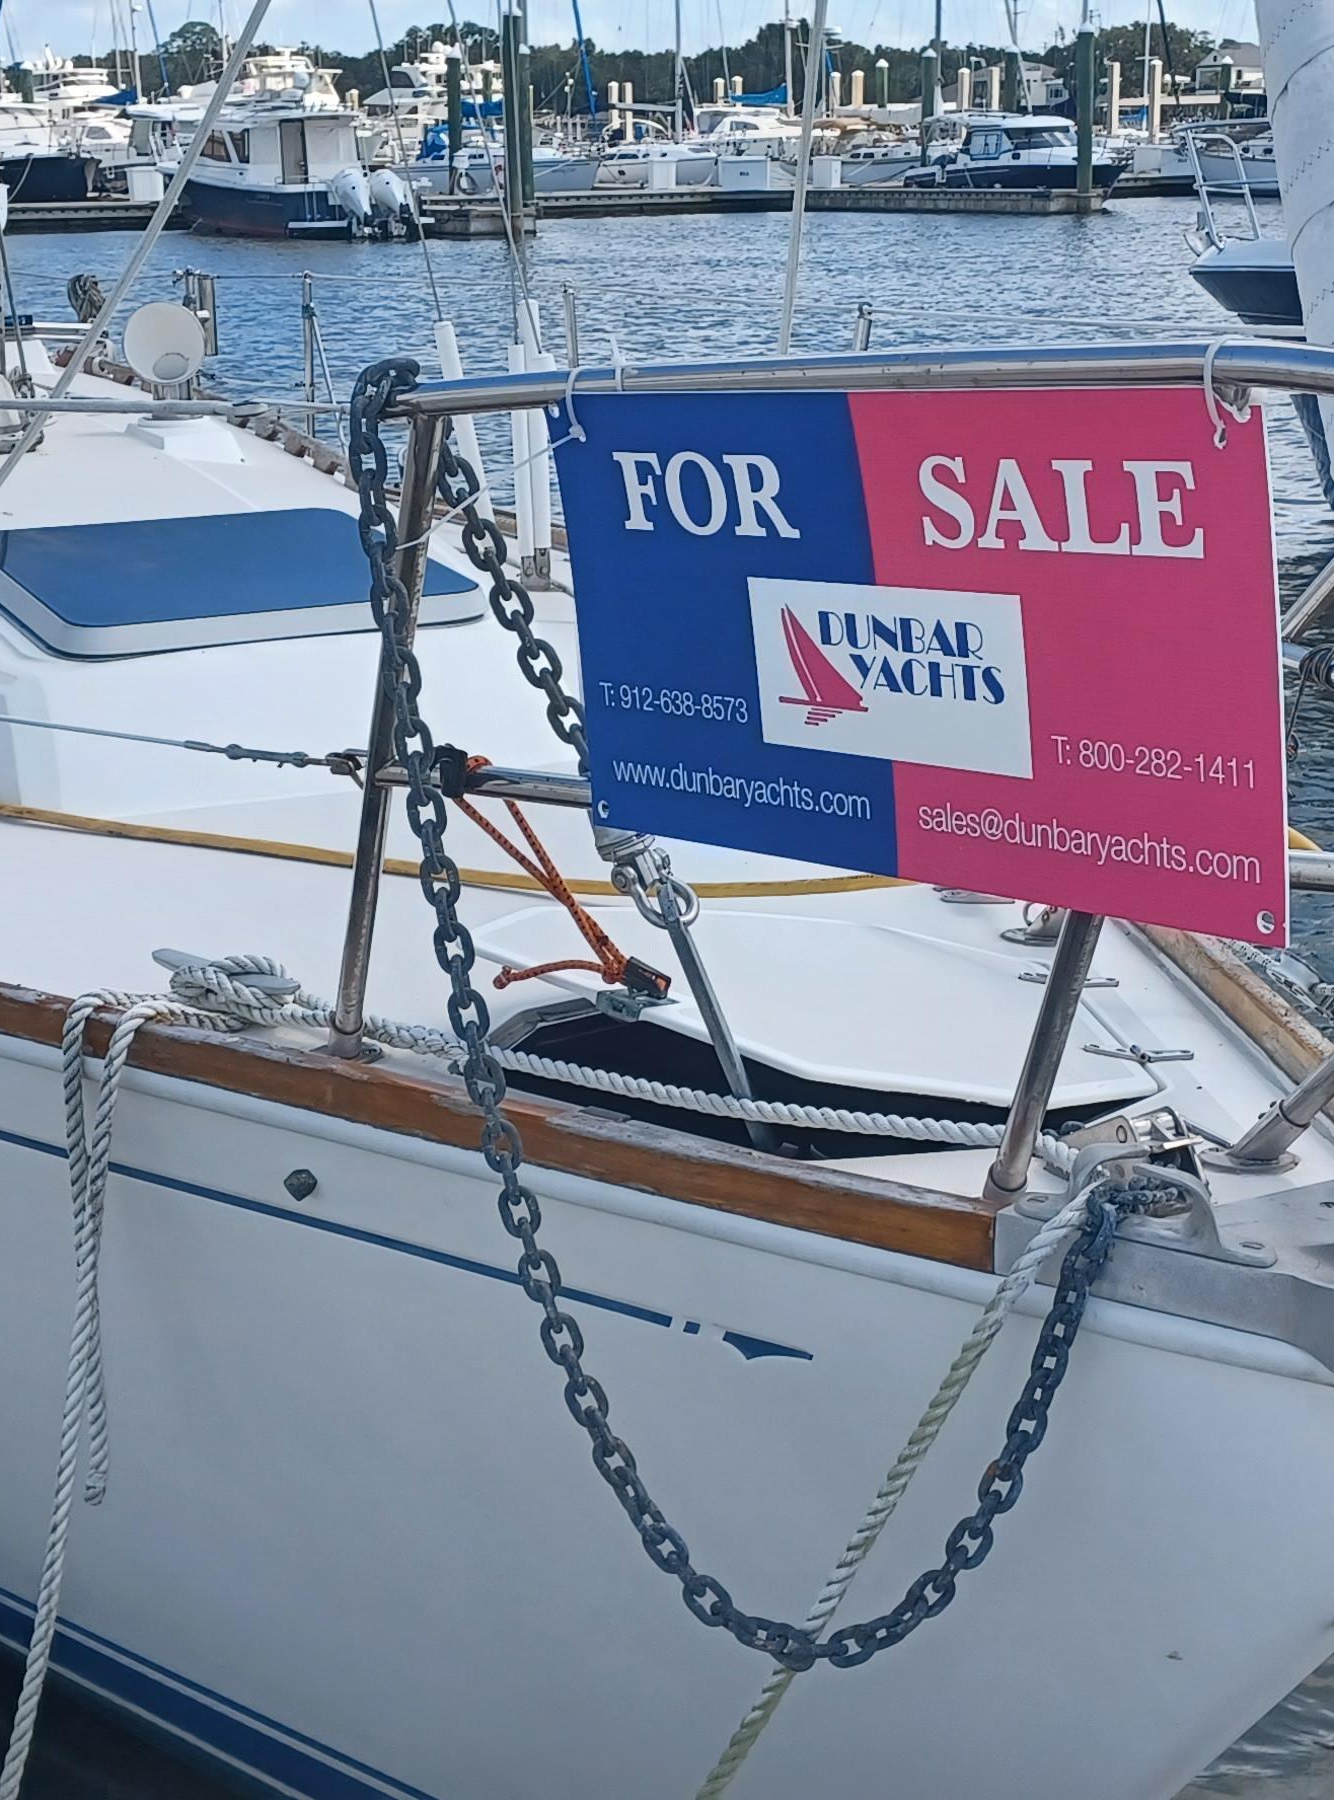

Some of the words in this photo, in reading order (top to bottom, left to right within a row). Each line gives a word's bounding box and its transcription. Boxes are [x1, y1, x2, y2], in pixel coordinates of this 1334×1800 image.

[612, 451, 800, 539] FOR
[919, 455, 1204, 559] SALE
[817, 610, 985, 661] DUNBAR
[599, 682, 616, 707] T:
[619, 684, 749, 724] 912-638-8573
[849, 653, 1006, 705] YACHTS
[1050, 735, 1072, 765] T:
[1078, 739, 1257, 789] 800-282-1411
[612, 759, 871, 820] www.dunbaryachts.com
[918, 802, 1262, 884] sales@dunbaryachts.com
